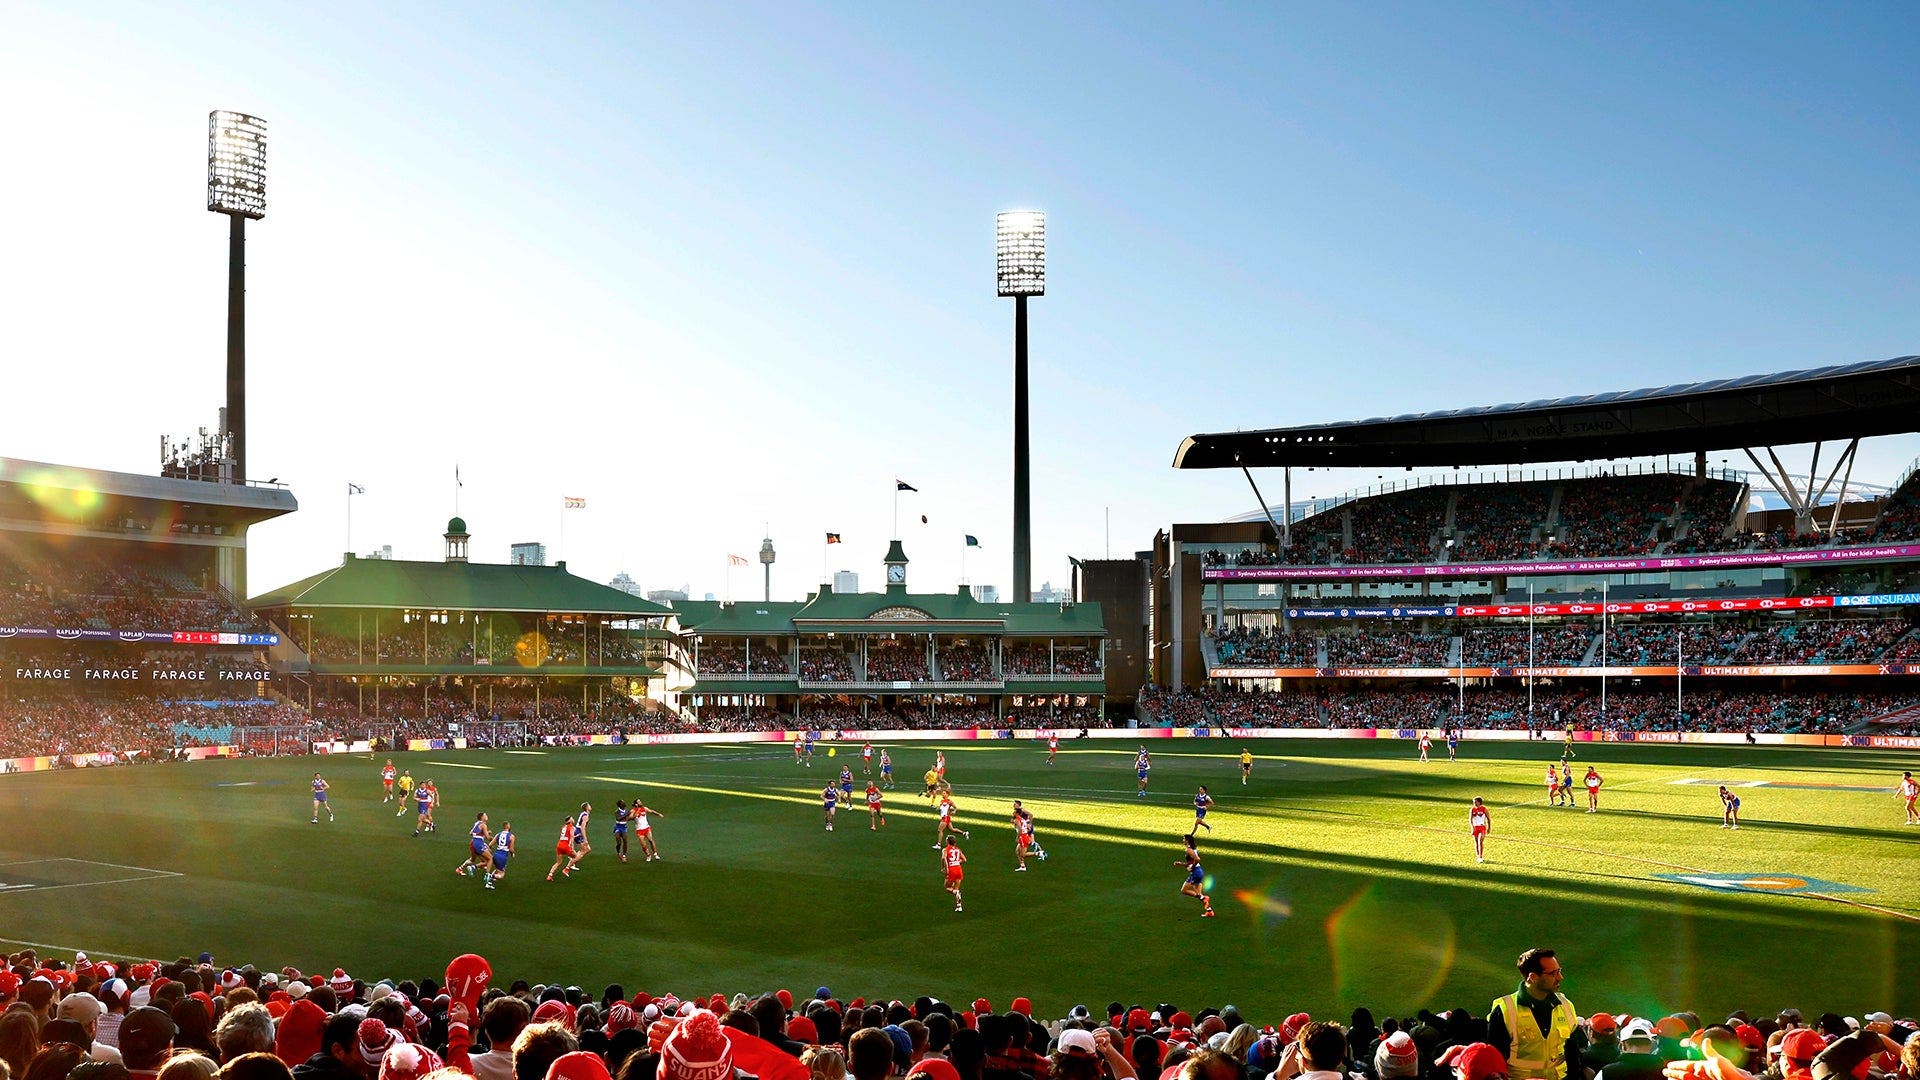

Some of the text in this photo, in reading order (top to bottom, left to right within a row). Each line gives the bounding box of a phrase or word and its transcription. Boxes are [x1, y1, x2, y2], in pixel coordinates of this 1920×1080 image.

[1851, 593, 1920, 605] QBE INSURAN
[16, 668, 71, 679] FARAGE
[85, 669, 139, 680] FARAGE
[152, 670, 206, 680] FARAGE
[219, 671, 271, 681] FARAGE
[1704, 667, 1749, 675] ULTIMATE
[1194, 728, 1210, 737] OMO
[1399, 729, 1416, 739] OMO
[1618, 732, 1635, 741] OMO
[431, 739, 446, 749] OMO
[1852, 736, 1920, 746] OMO ULTIMAT
[475, 969, 488, 983] QBE
[669, 1057, 727, 1080] SWANS
